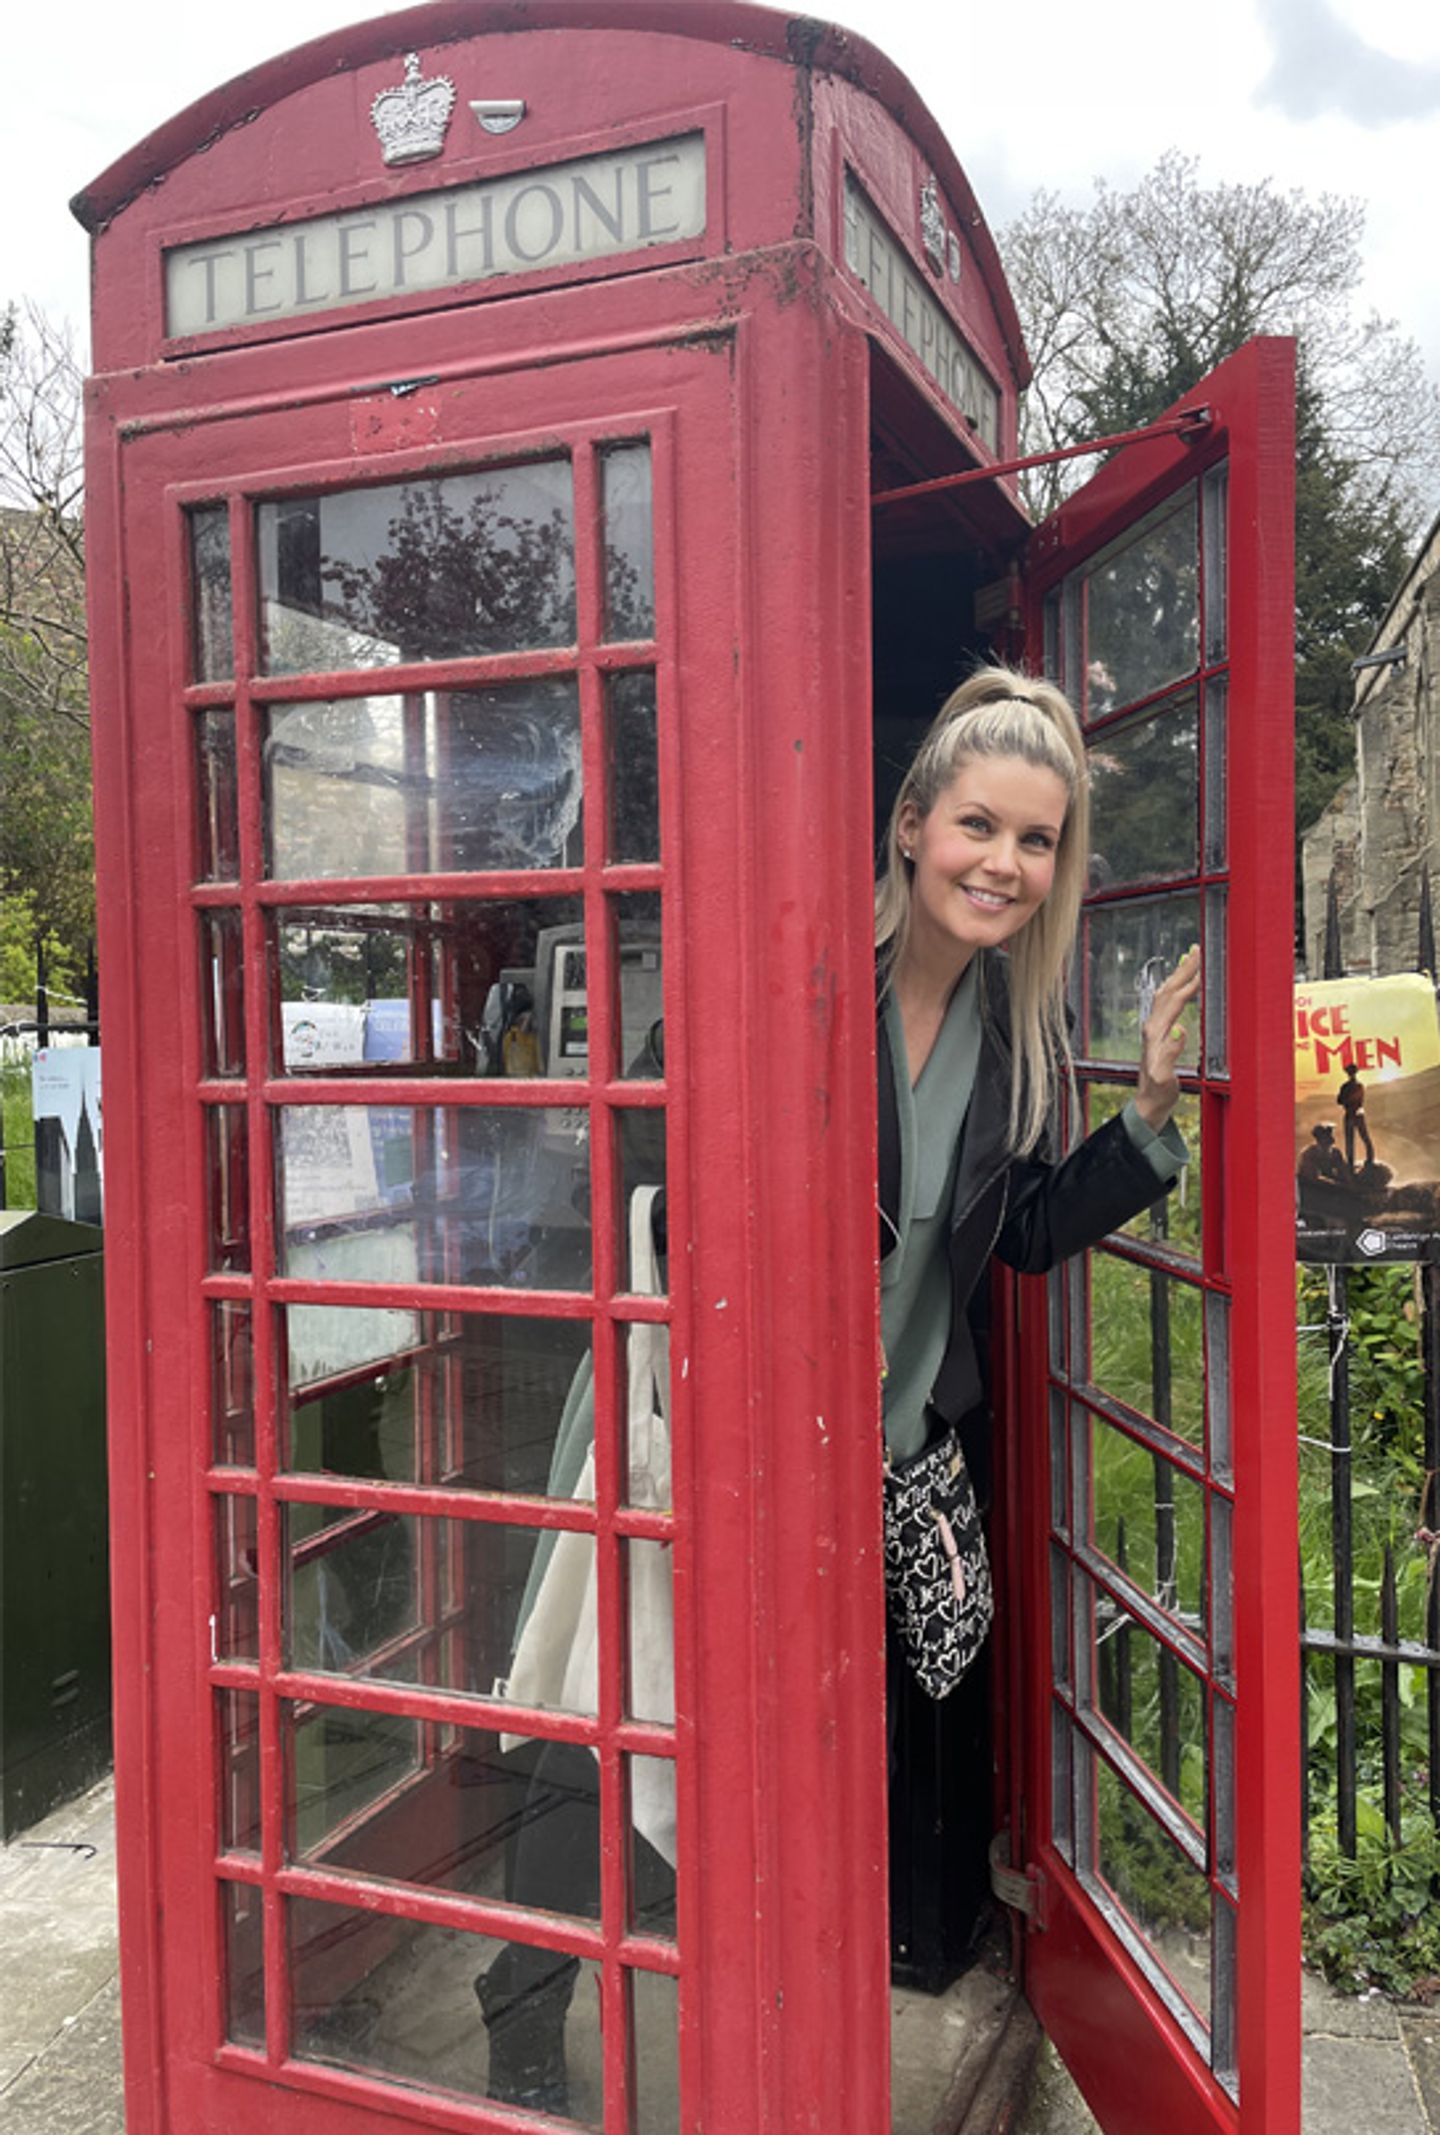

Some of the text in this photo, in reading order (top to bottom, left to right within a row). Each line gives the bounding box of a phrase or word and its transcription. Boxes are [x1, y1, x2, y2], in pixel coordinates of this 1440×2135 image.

[188, 154, 681, 323] TELEPHONE
[1295, 1004, 1351, 1038] ICE
[1314, 1035, 1402, 1074] MEN
